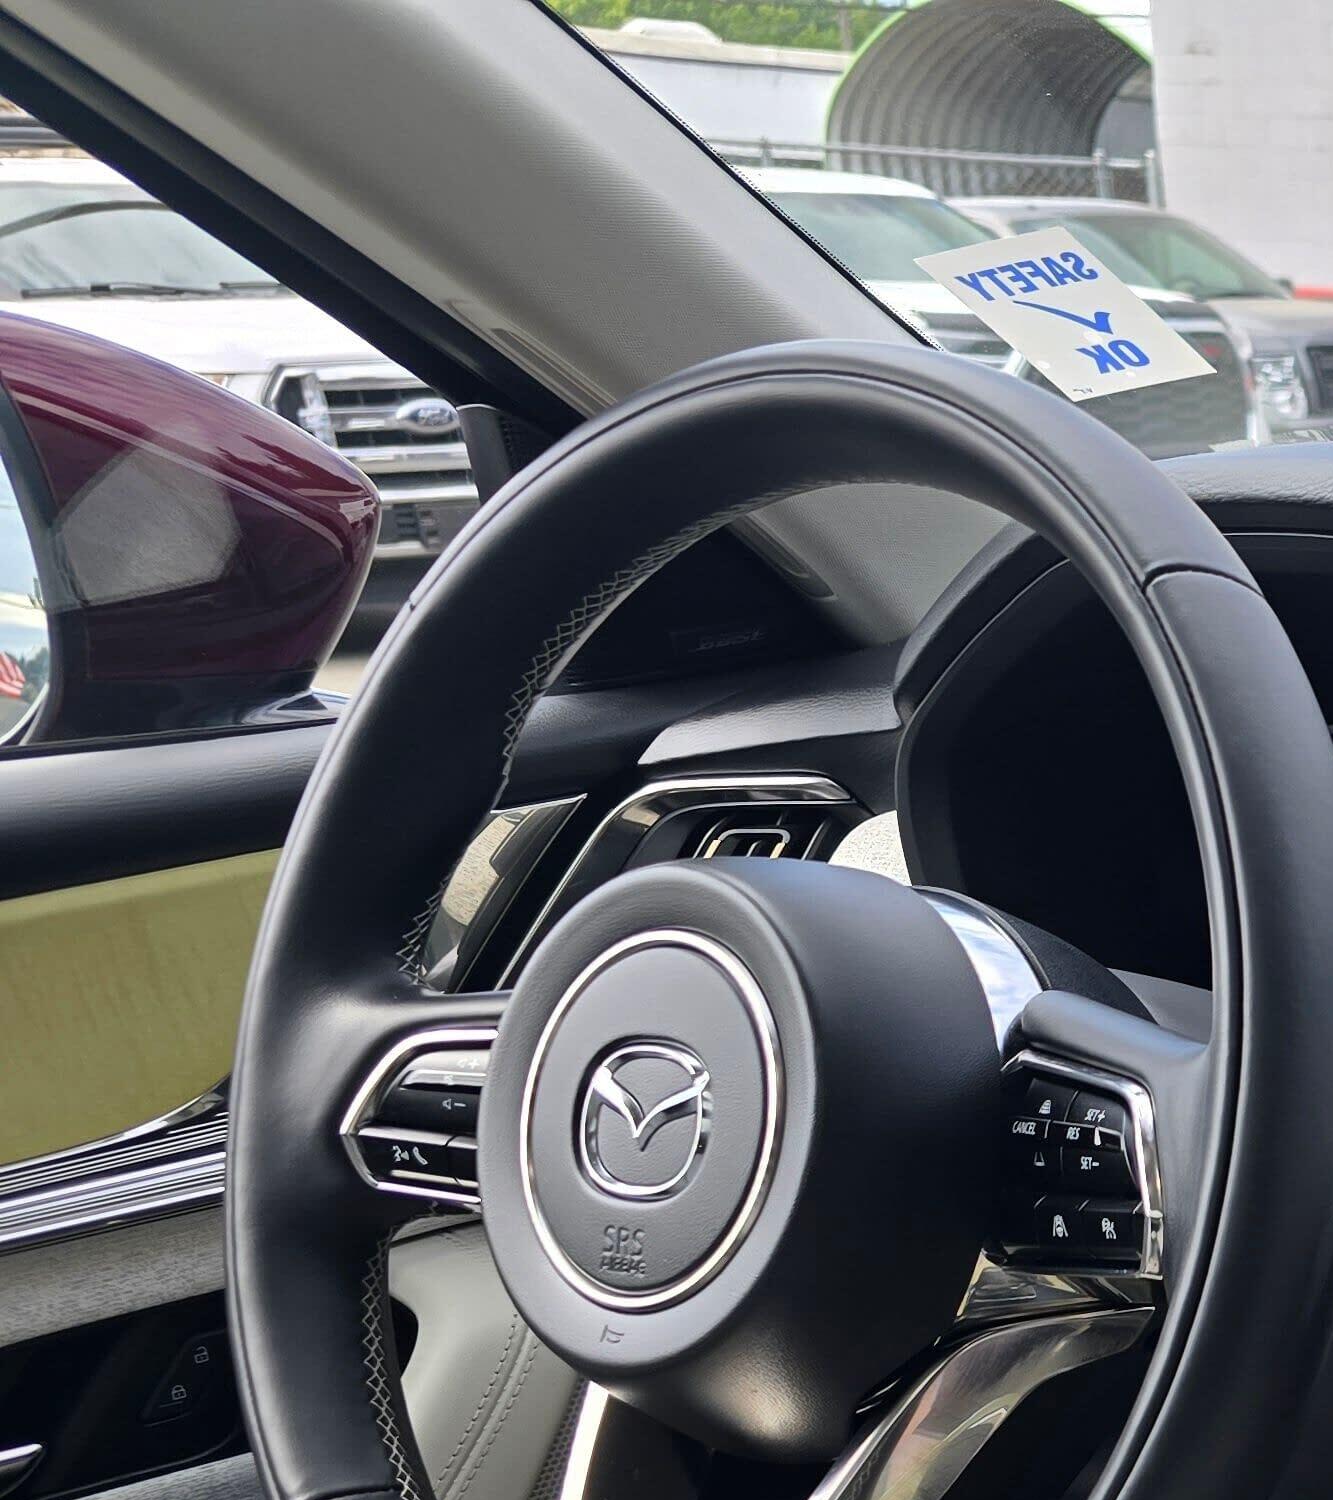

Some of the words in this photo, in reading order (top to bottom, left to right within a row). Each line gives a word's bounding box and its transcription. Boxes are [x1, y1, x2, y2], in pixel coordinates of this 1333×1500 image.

[1012, 1120, 1037, 1135] CANCEL
[1066, 1126, 1081, 1140] RES
[602, 1224, 647, 1255] SRS
